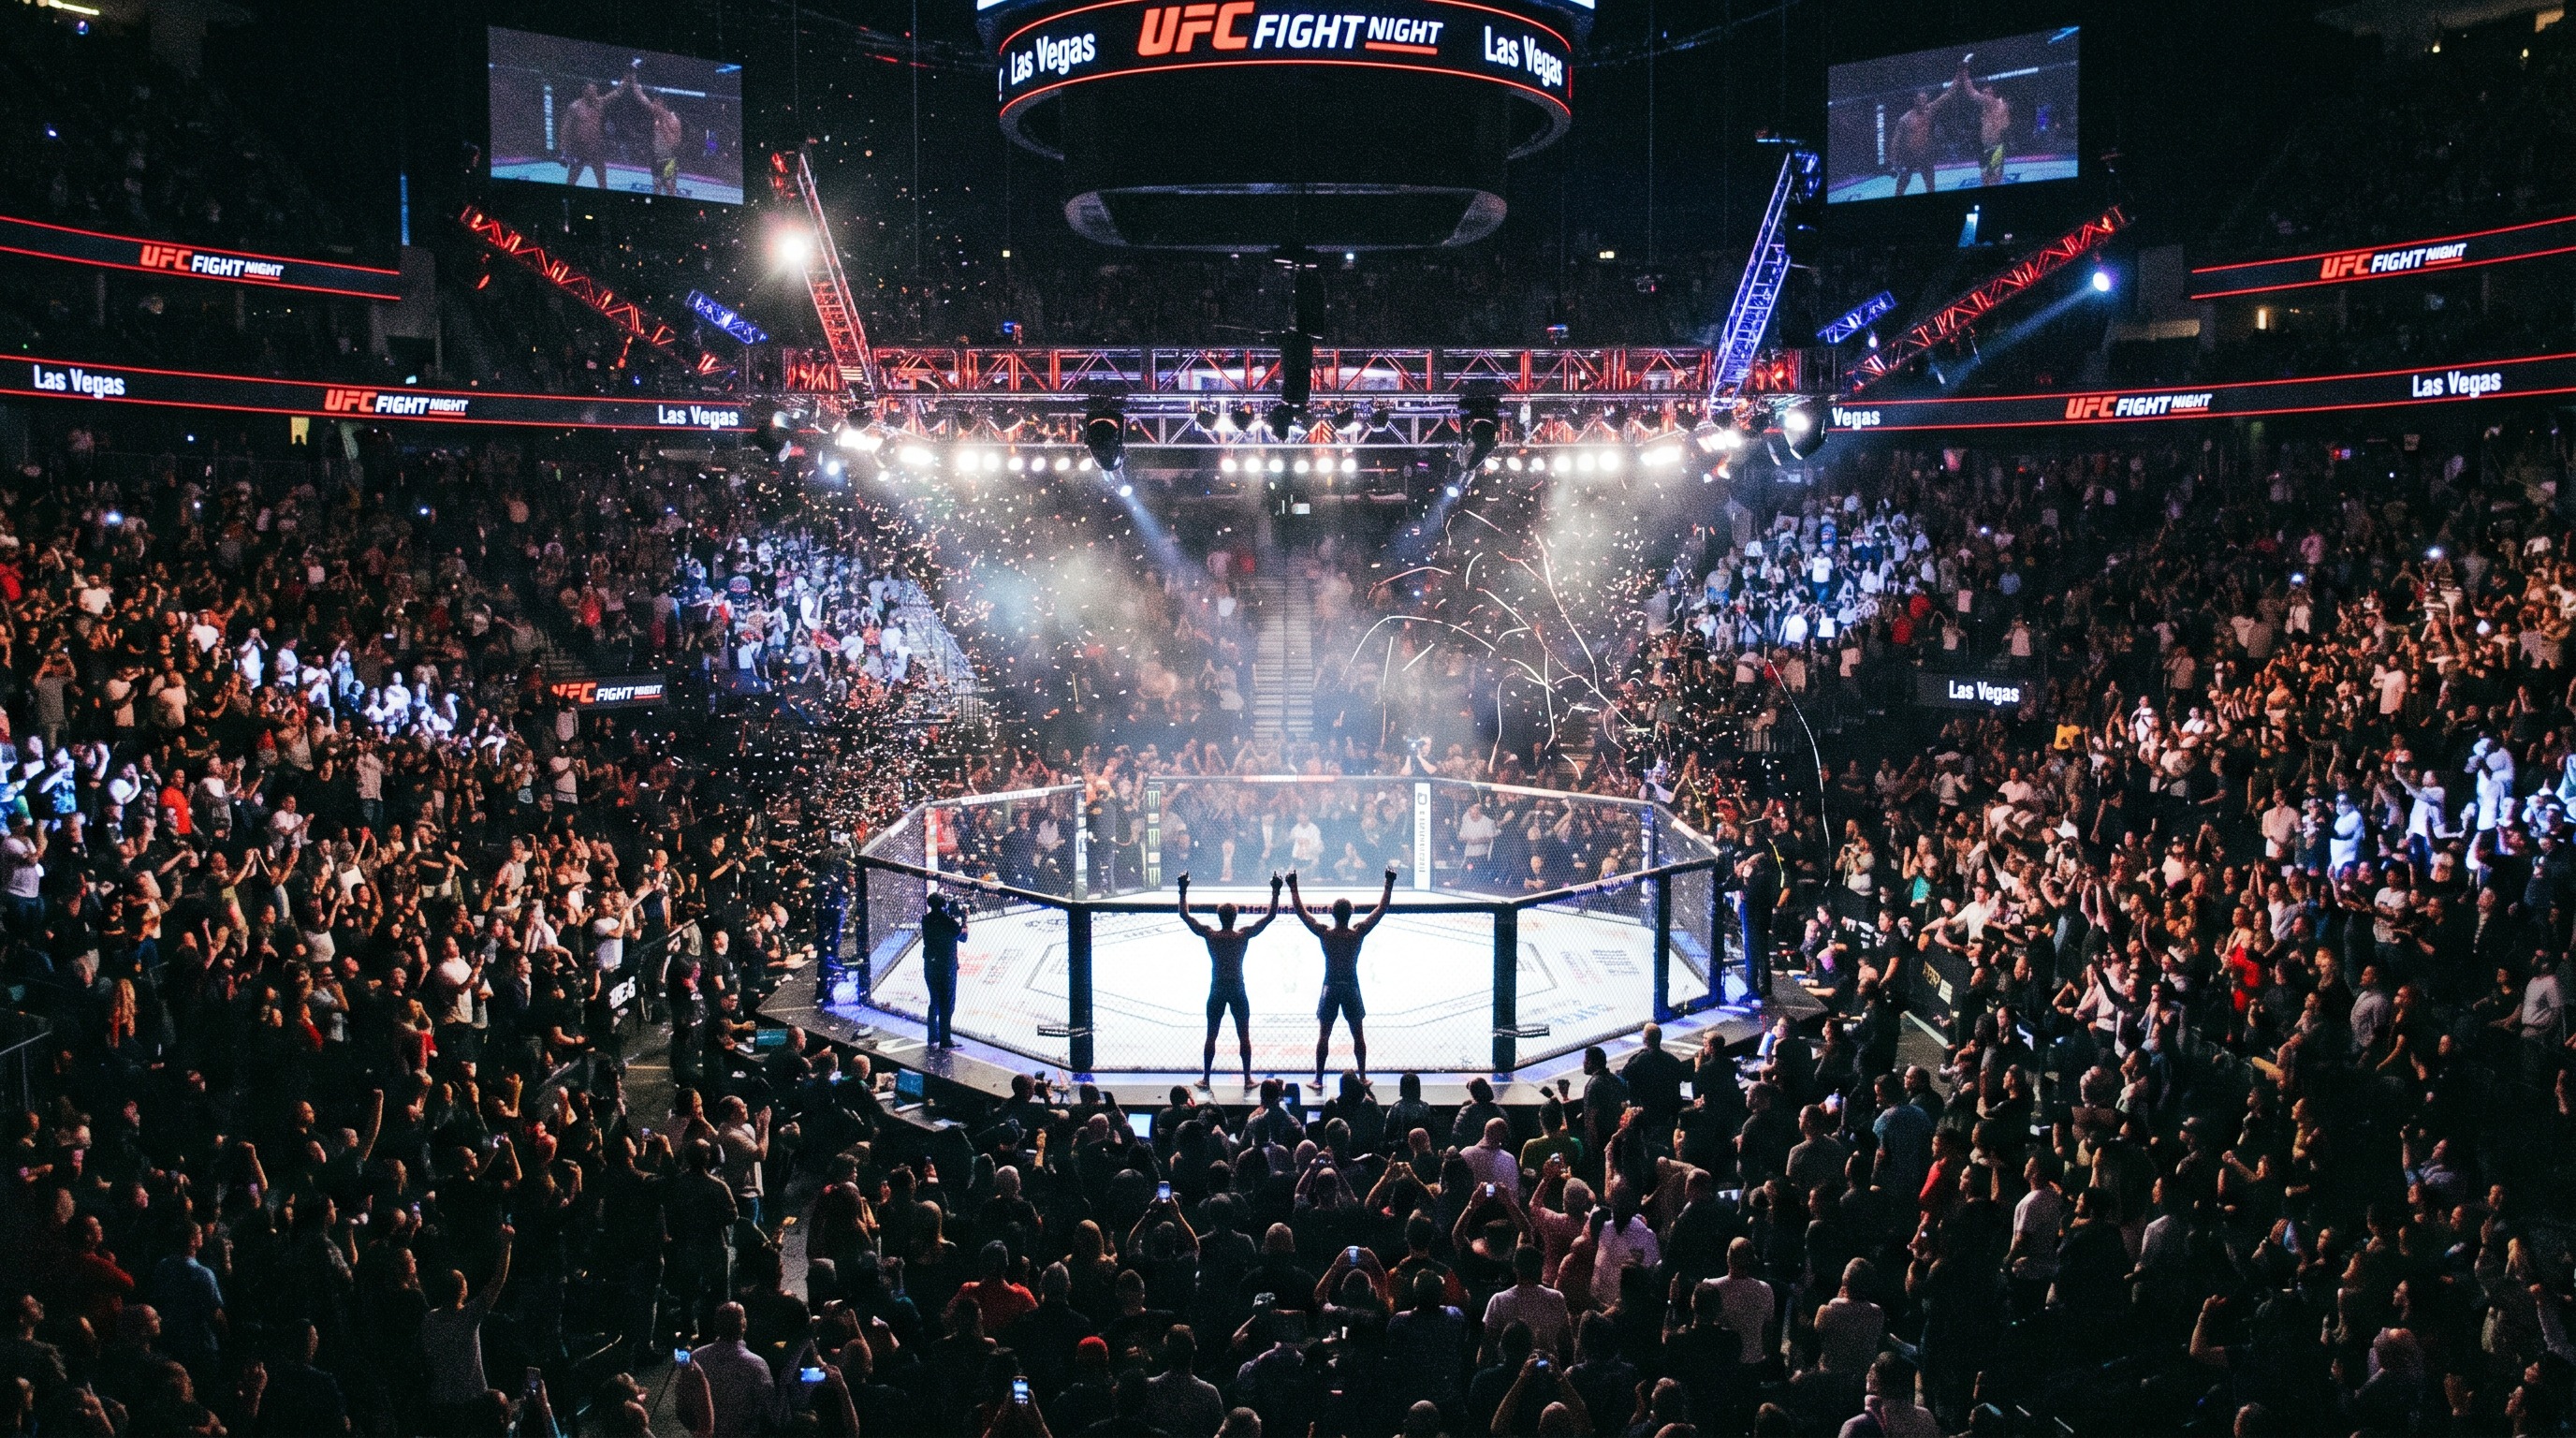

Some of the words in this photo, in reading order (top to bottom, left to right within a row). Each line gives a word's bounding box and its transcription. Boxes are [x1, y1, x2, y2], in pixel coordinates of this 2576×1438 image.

[1137, 1, 1254, 56] UFC
[1252, 14, 1366, 49] FIGHT
[1367, 16, 1443, 44] NIGHT
[1011, 51, 1033, 85] Las
[1036, 33, 1095, 75] Vegas
[1485, 25, 1518, 67] Las
[1523, 35, 1562, 87] Vegas
[141, 244, 193, 271] UFC
[191, 255, 244, 277] FIGHT
[244, 261, 284, 276] NIGHT
[2320, 253, 2372, 279] UFC
[2371, 248, 2426, 273] FIGHT
[2425, 242, 2466, 261] NIGHT
[34, 365, 66, 391] Las
[70, 368, 124, 399] Vegas
[2413, 375, 2444, 397] Las
[2448, 371, 2502, 398] Vegas
[325, 389, 377, 413] UFC
[374, 395, 429, 415] FIGHT
[429, 398, 469, 412] NIGHT
[2065, 396, 2117, 418] UFC
[2115, 396, 2172, 417] FIGHT
[2171, 393, 2212, 408] NIGHT
[658, 404, 686, 425] Las
[690, 405, 739, 430] Vegas
[1832, 407, 1881, 430] Vegas
[595, 686, 634, 701] FIGHT
[1949, 680, 1974, 700] Las
[1977, 682, 2020, 706] Vegas
